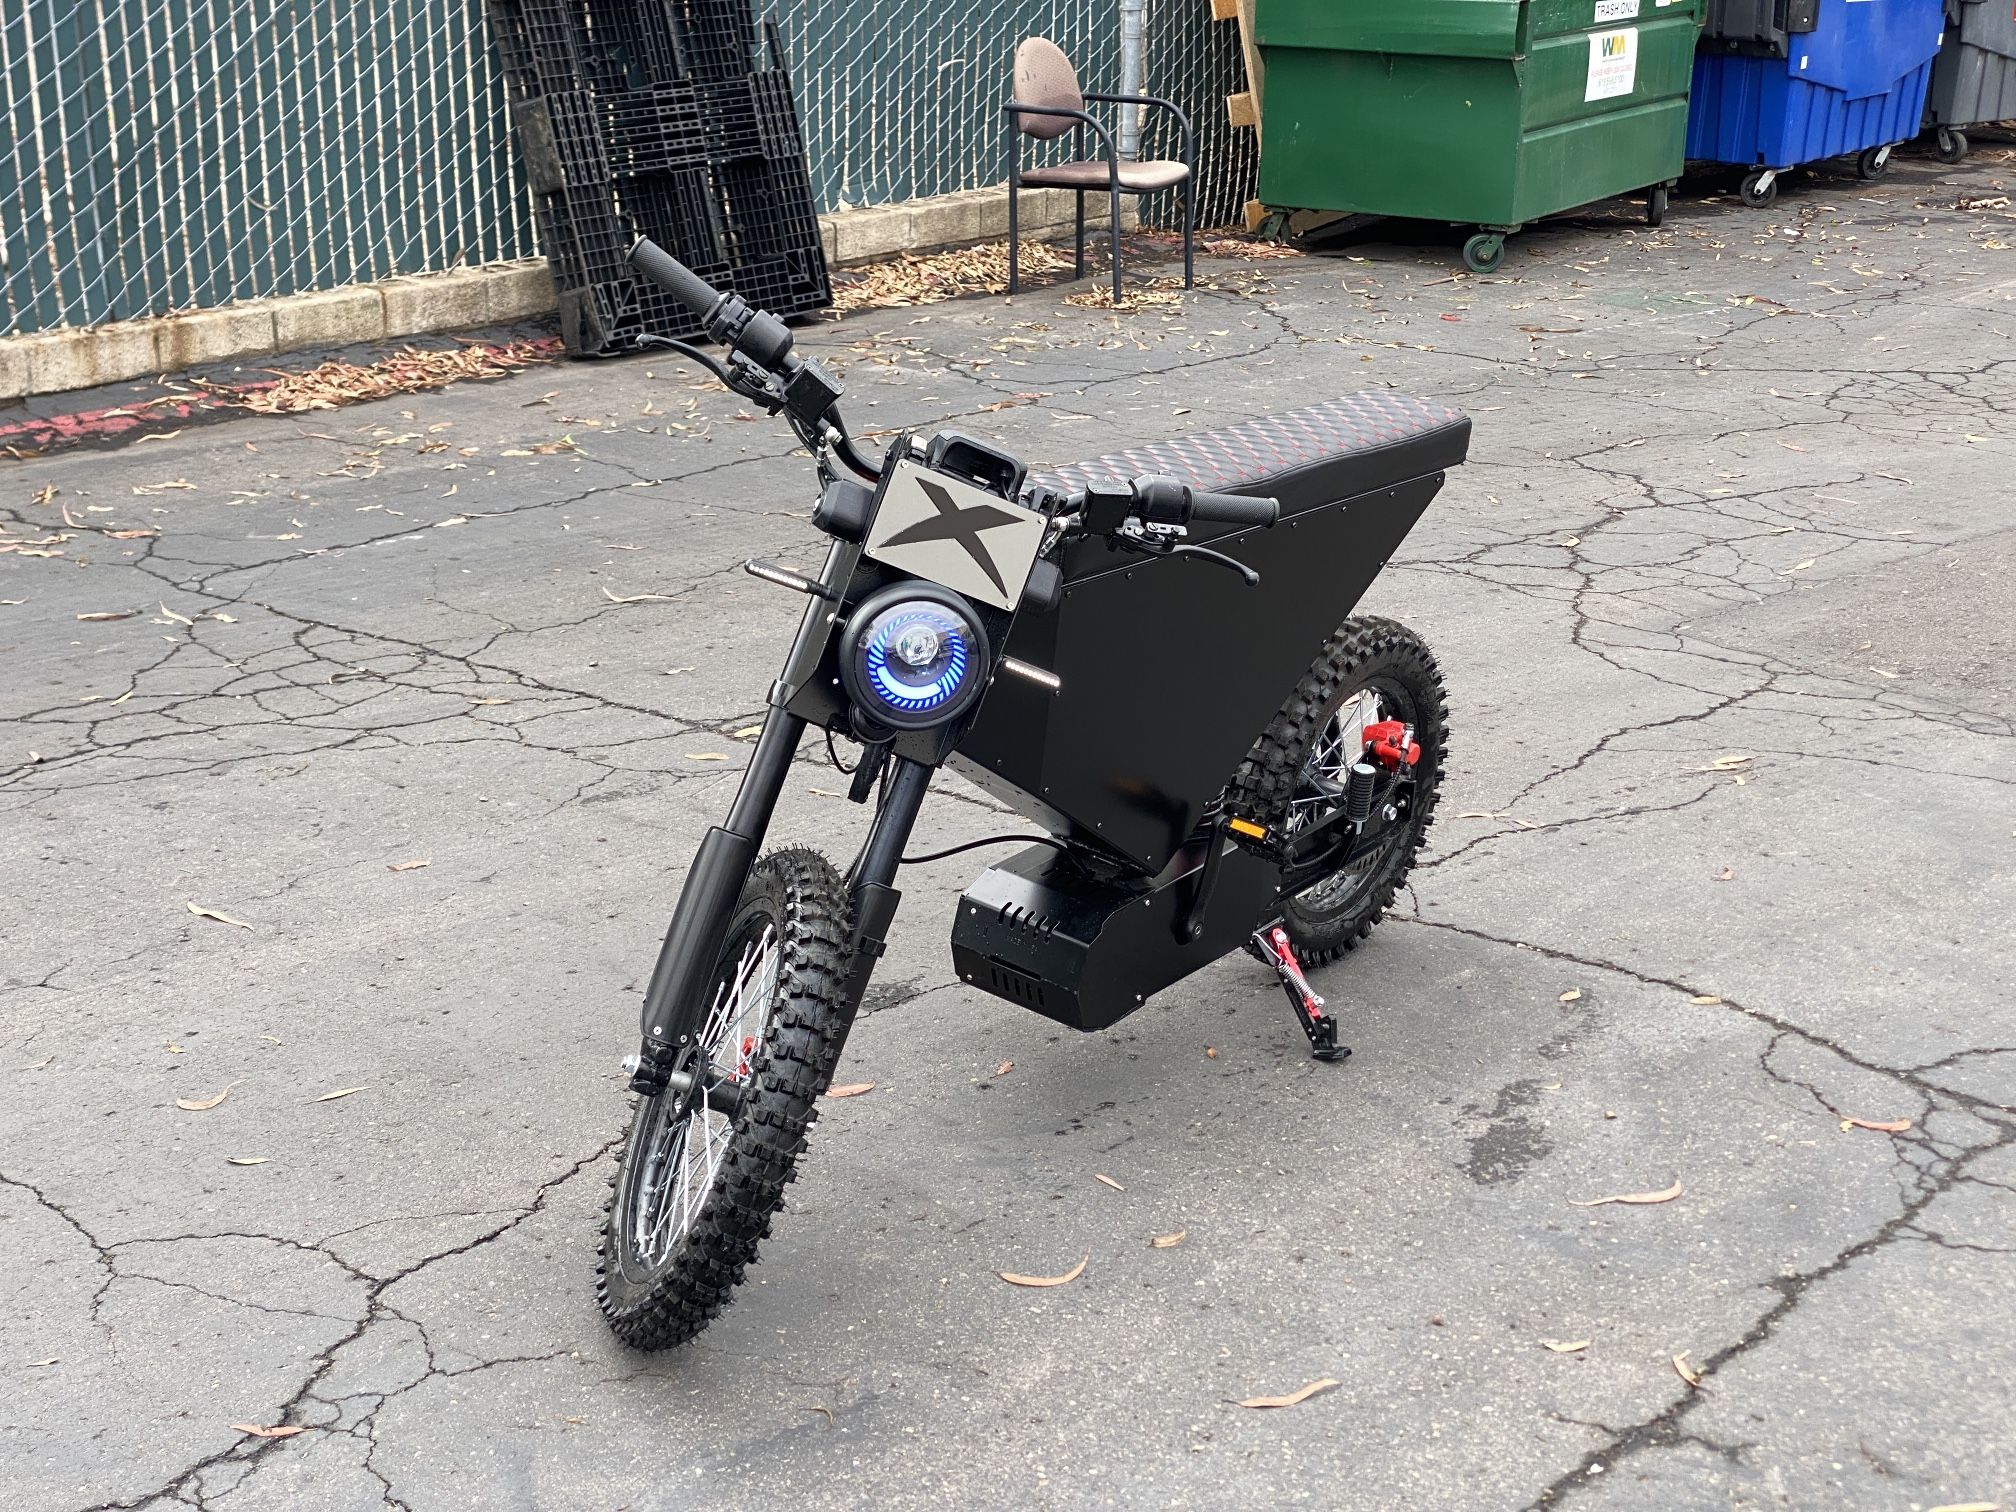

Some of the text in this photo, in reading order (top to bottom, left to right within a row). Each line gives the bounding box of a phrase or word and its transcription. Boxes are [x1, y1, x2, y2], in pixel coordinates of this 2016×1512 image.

[1597, 1, 1638, 17] TRASH ONLY
[1602, 35, 1625, 57] WM
